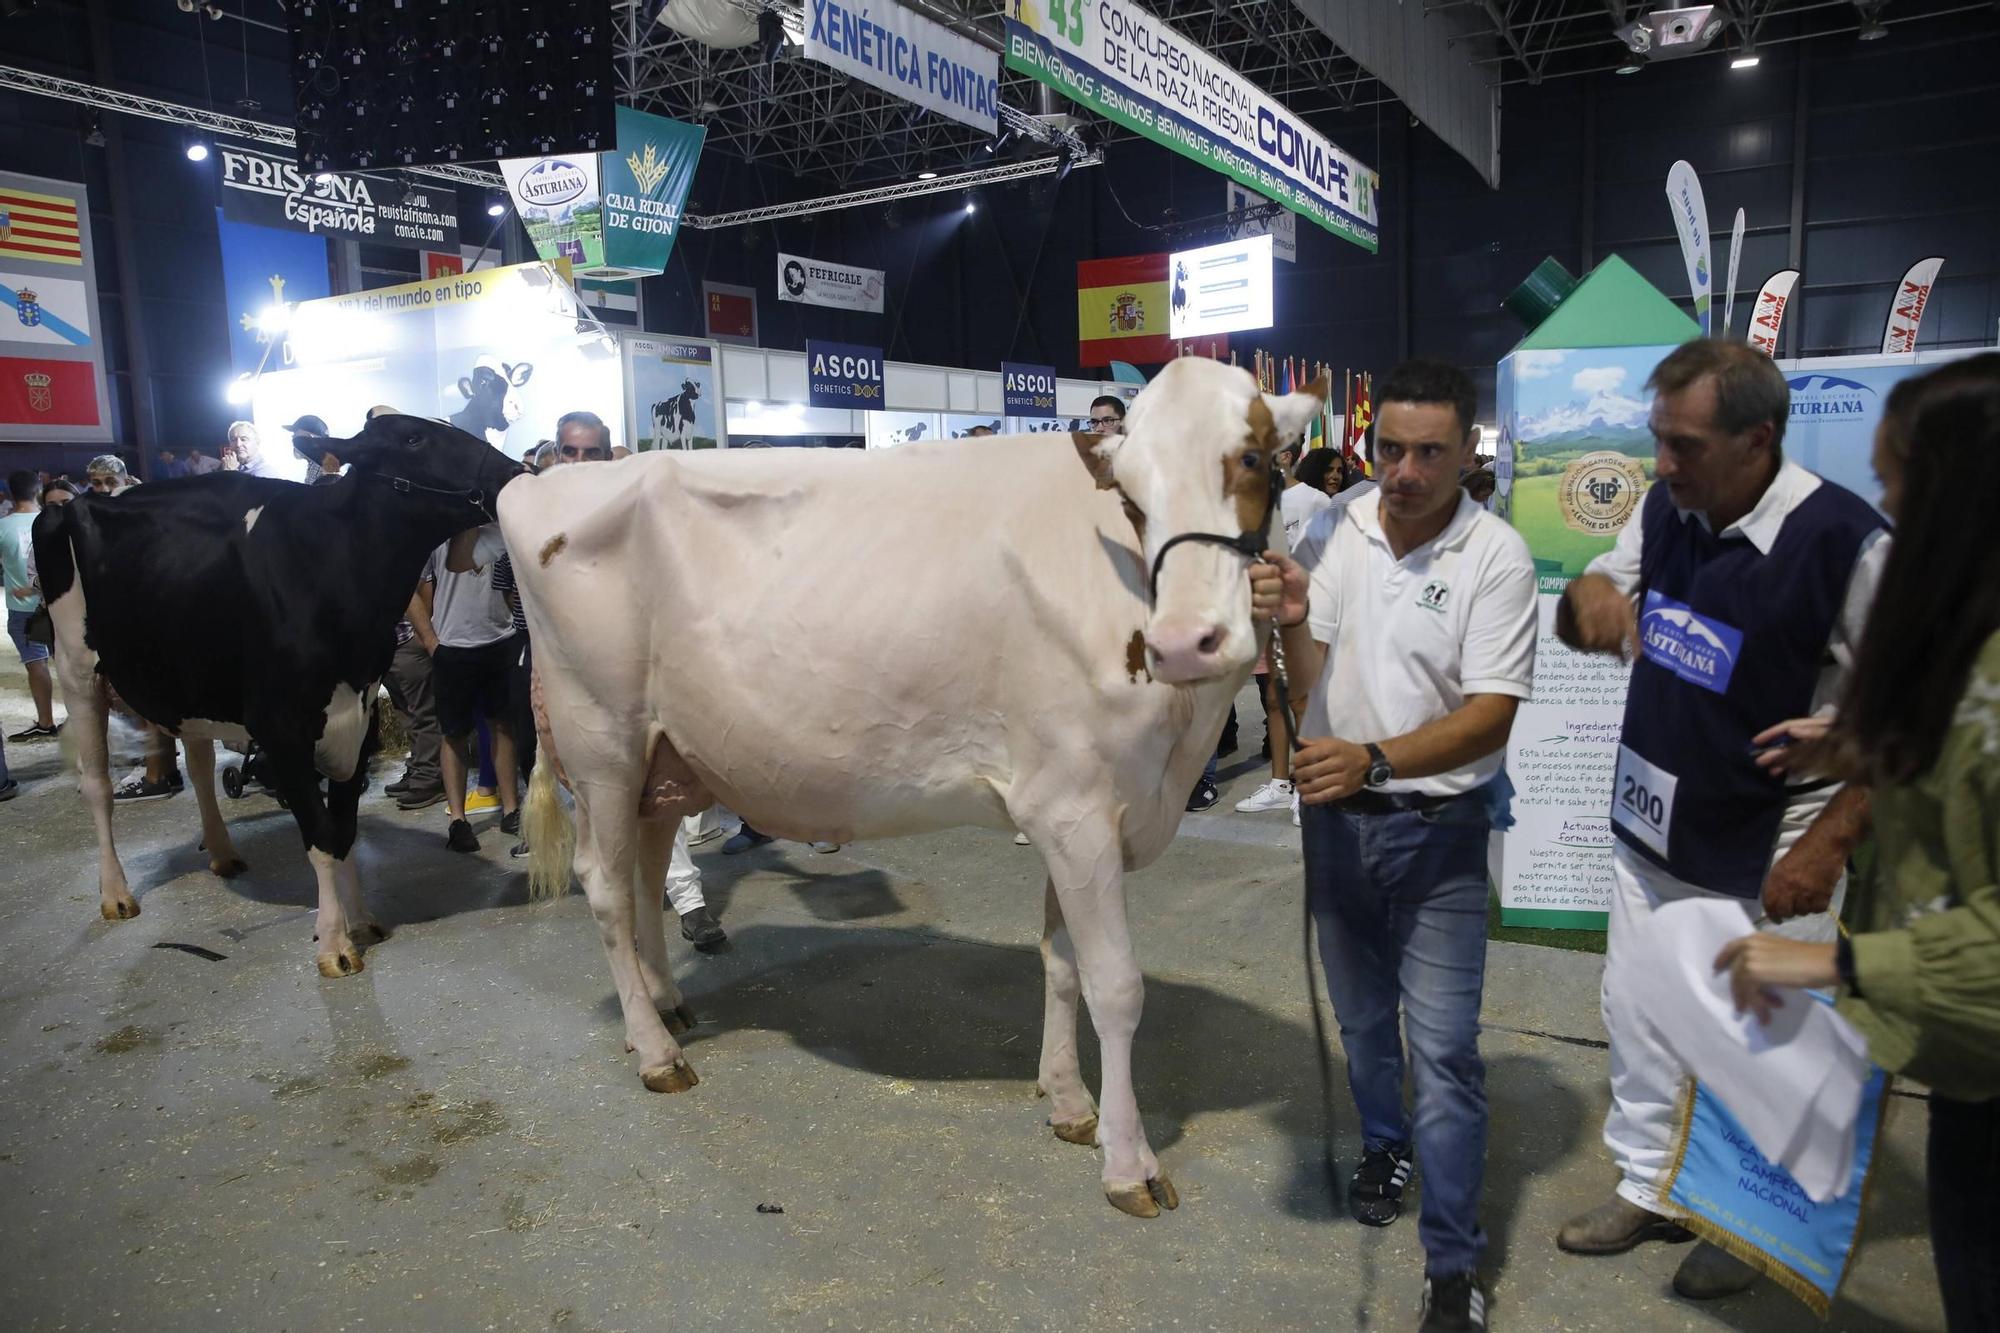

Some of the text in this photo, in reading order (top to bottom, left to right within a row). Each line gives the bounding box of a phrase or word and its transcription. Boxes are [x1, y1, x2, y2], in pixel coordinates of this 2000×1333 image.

[810, 0, 923, 89] XENÉTICA
[1099, 0, 1256, 120] CONCURSO NACIONAL
[1104, 37, 1256, 147] DE LA RAZA FRISONA
[1101, 84, 1153, 128] BENVIDOS
[525, 177, 583, 198] ASTURIANA
[285, 193, 375, 234] Española
[605, 193, 680, 219] CAJA RURAL
[378, 203, 457, 228] revistafrisona.com
[609, 212, 628, 228] DE
[394, 224, 444, 242] conafe.com
[808, 266, 863, 286] FEFRICALE
[364, 294, 382, 312] del
[386, 287, 431, 309] mundo
[435, 285, 451, 301] en
[455, 280, 482, 300] tipo
[1910, 284, 1930, 322] NANTA
[1770, 296, 1786, 331] NANTA
[813, 353, 882, 381] ASCOL
[813, 383, 852, 395] GENETICS
[1006, 373, 1055, 394] ASCOL
[1006, 396, 1034, 406] GENETICS
[1789, 400, 1864, 415] TURIANA
[1573, 511, 1598, 529] LECHE
[1540, 659, 1548, 668] la
[1571, 659, 1580, 669] lo
[1582, 661, 1618, 669] sabemos
[1577, 672, 1588, 681] de
[1590, 671, 1605, 681] ella
[1548, 683, 1602, 693] esforzamos
[1604, 687, 1620, 695] por
[1573, 733, 1620, 744] naturales
[1519, 749, 1540, 757] Esta
[1542, 749, 1570, 758] Leche
[1532, 764, 1572, 772] procesos
[1544, 773, 1552, 781] el
[1555, 774, 1577, 782] único
[1579, 773, 1593, 783] fin
[1519, 796, 1552, 805] natural
[1554, 798, 1565, 806] te
[1567, 798, 1587, 806] sabe
[1621, 775, 1663, 826] 200
[1562, 820, 1609, 832] Actuamos
[1558, 833, 1614, 844] forma natu
[1529, 849, 1564, 858] Nuestro
[1566, 852, 1594, 861] origen
[1587, 863, 1615, 872] transp
[1518, 873, 1568, 881] mostrarnos
[1571, 873, 1583, 881] tal
[1531, 883, 1541, 891] te
[1543, 885, 1589, 894] enseñamos
[1591, 884, 1603, 894] los
[1513, 895, 1532, 903] esta
[1534, 895, 1557, 904] leche
[1560, 896, 1570, 905] de
[1573, 895, 1598, 905] forma
[1739, 1158, 1817, 1211] CAMPEON
[1737, 1175, 1809, 1225] NACIONAL
